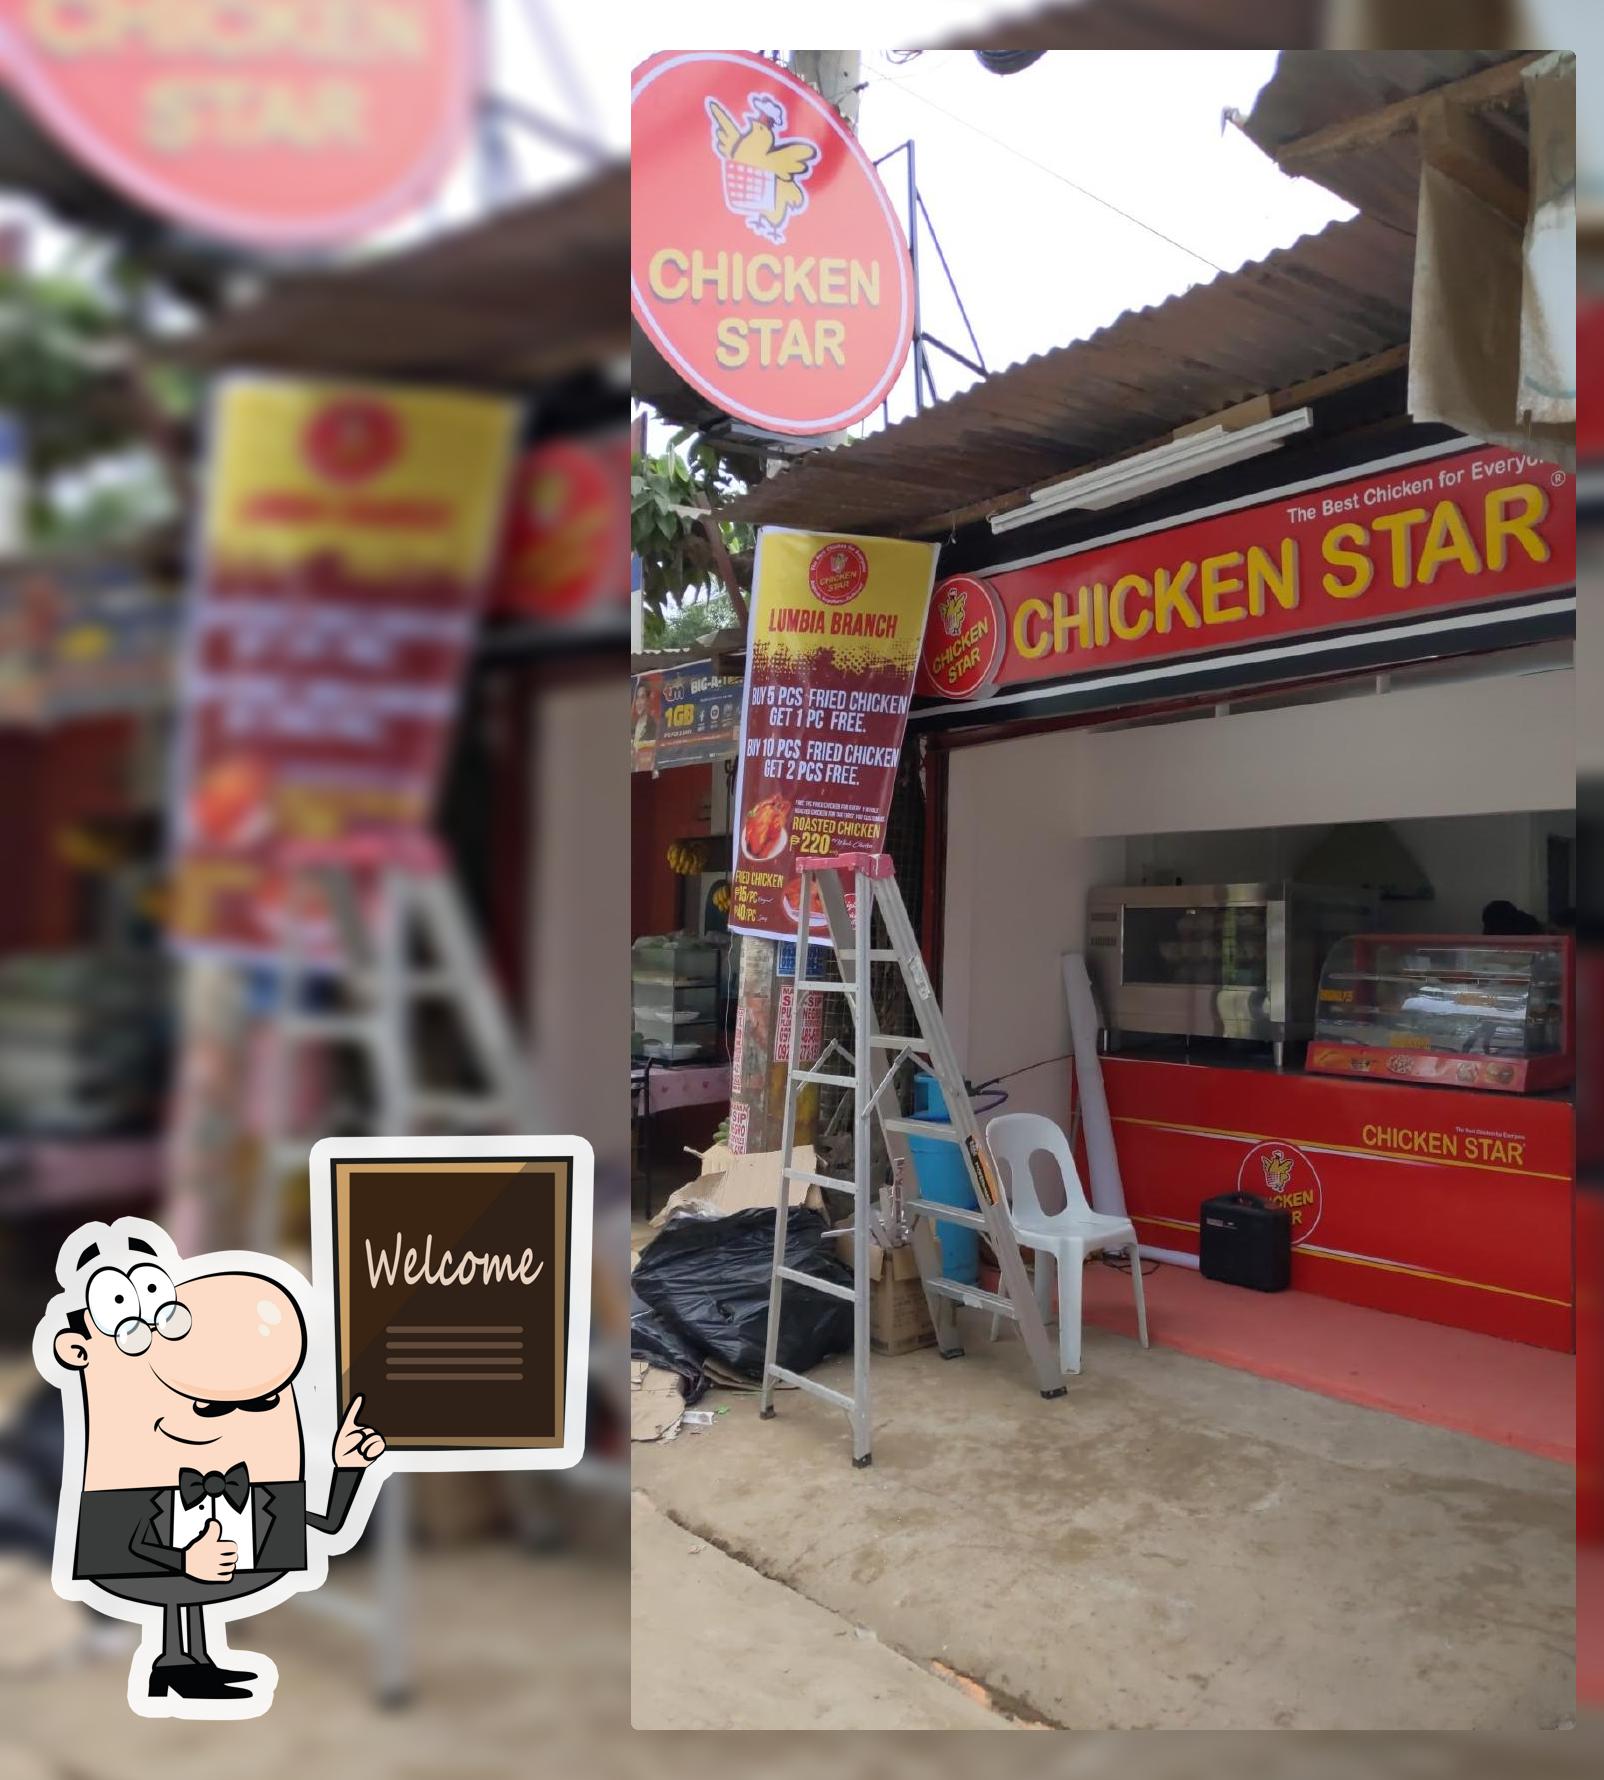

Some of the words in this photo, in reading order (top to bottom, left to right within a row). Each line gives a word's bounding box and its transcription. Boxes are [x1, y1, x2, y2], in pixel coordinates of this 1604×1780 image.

[648, 248, 880, 307] CHICKEN
[715, 318, 846, 369] STAR
[1286, 508, 1317, 525] The
[1322, 493, 1359, 517] Best
[1363, 476, 1434, 507] Chicken
[1438, 468, 1465, 488] for
[820, 571, 857, 586] CHICKEN
[1012, 537, 1300, 660] CHICKEN
[1321, 482, 1552, 600] STAR
[768, 608, 825, 634] LUMBIA
[830, 612, 898, 639] BRANCH
[932, 616, 989, 675] CHICKEN
[948, 647, 981, 684] STAR
[752, 687, 767, 706] BUY
[767, 685, 775, 704] 5
[778, 686, 804, 707] PCS
[809, 689, 847, 711] FRIED
[849, 691, 908, 715] CHICKEN
[769, 707, 793, 727] GET
[796, 708, 803, 728] 1
[806, 709, 824, 730] PC
[830, 711, 867, 733] FREE.
[747, 738, 761, 758] BUY
[762, 739, 775, 759] 10
[779, 739, 802, 760] PCS
[807, 740, 843, 762] FRIED
[844, 745, 900, 768] CHICKEN
[764, 759, 785, 778] GET
[787, 761, 795, 780] 2
[797, 761, 823, 782] PCS
[825, 764, 860, 786] FREE.
[792, 816, 836, 834] ROASTED
[837, 821, 881, 839] CHICKEN
[735, 870, 750, 885] FRIED
[751, 871, 784, 889] CHICKEN
[1362, 1124, 1457, 1156] CHICKEN
[1464, 1137, 1524, 1165] STAR
